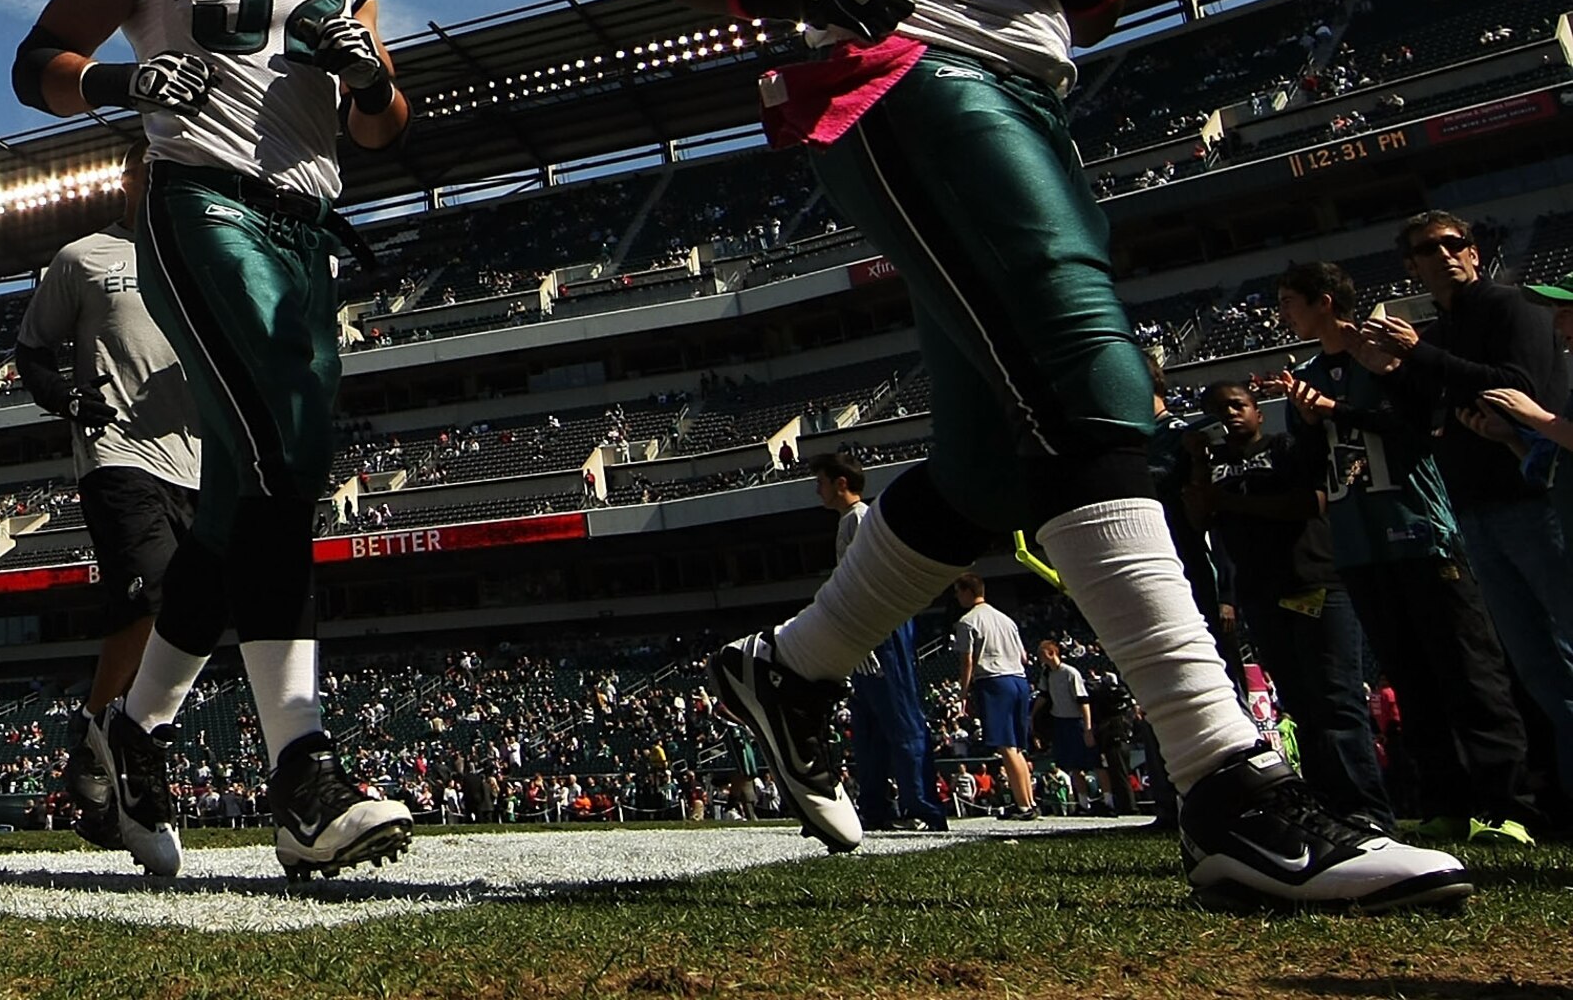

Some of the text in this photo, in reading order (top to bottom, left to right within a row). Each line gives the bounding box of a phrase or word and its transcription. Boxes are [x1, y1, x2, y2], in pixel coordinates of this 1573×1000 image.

[1308, 131, 1407, 169] 12:31 PM
[352, 529, 441, 558] BETTER
